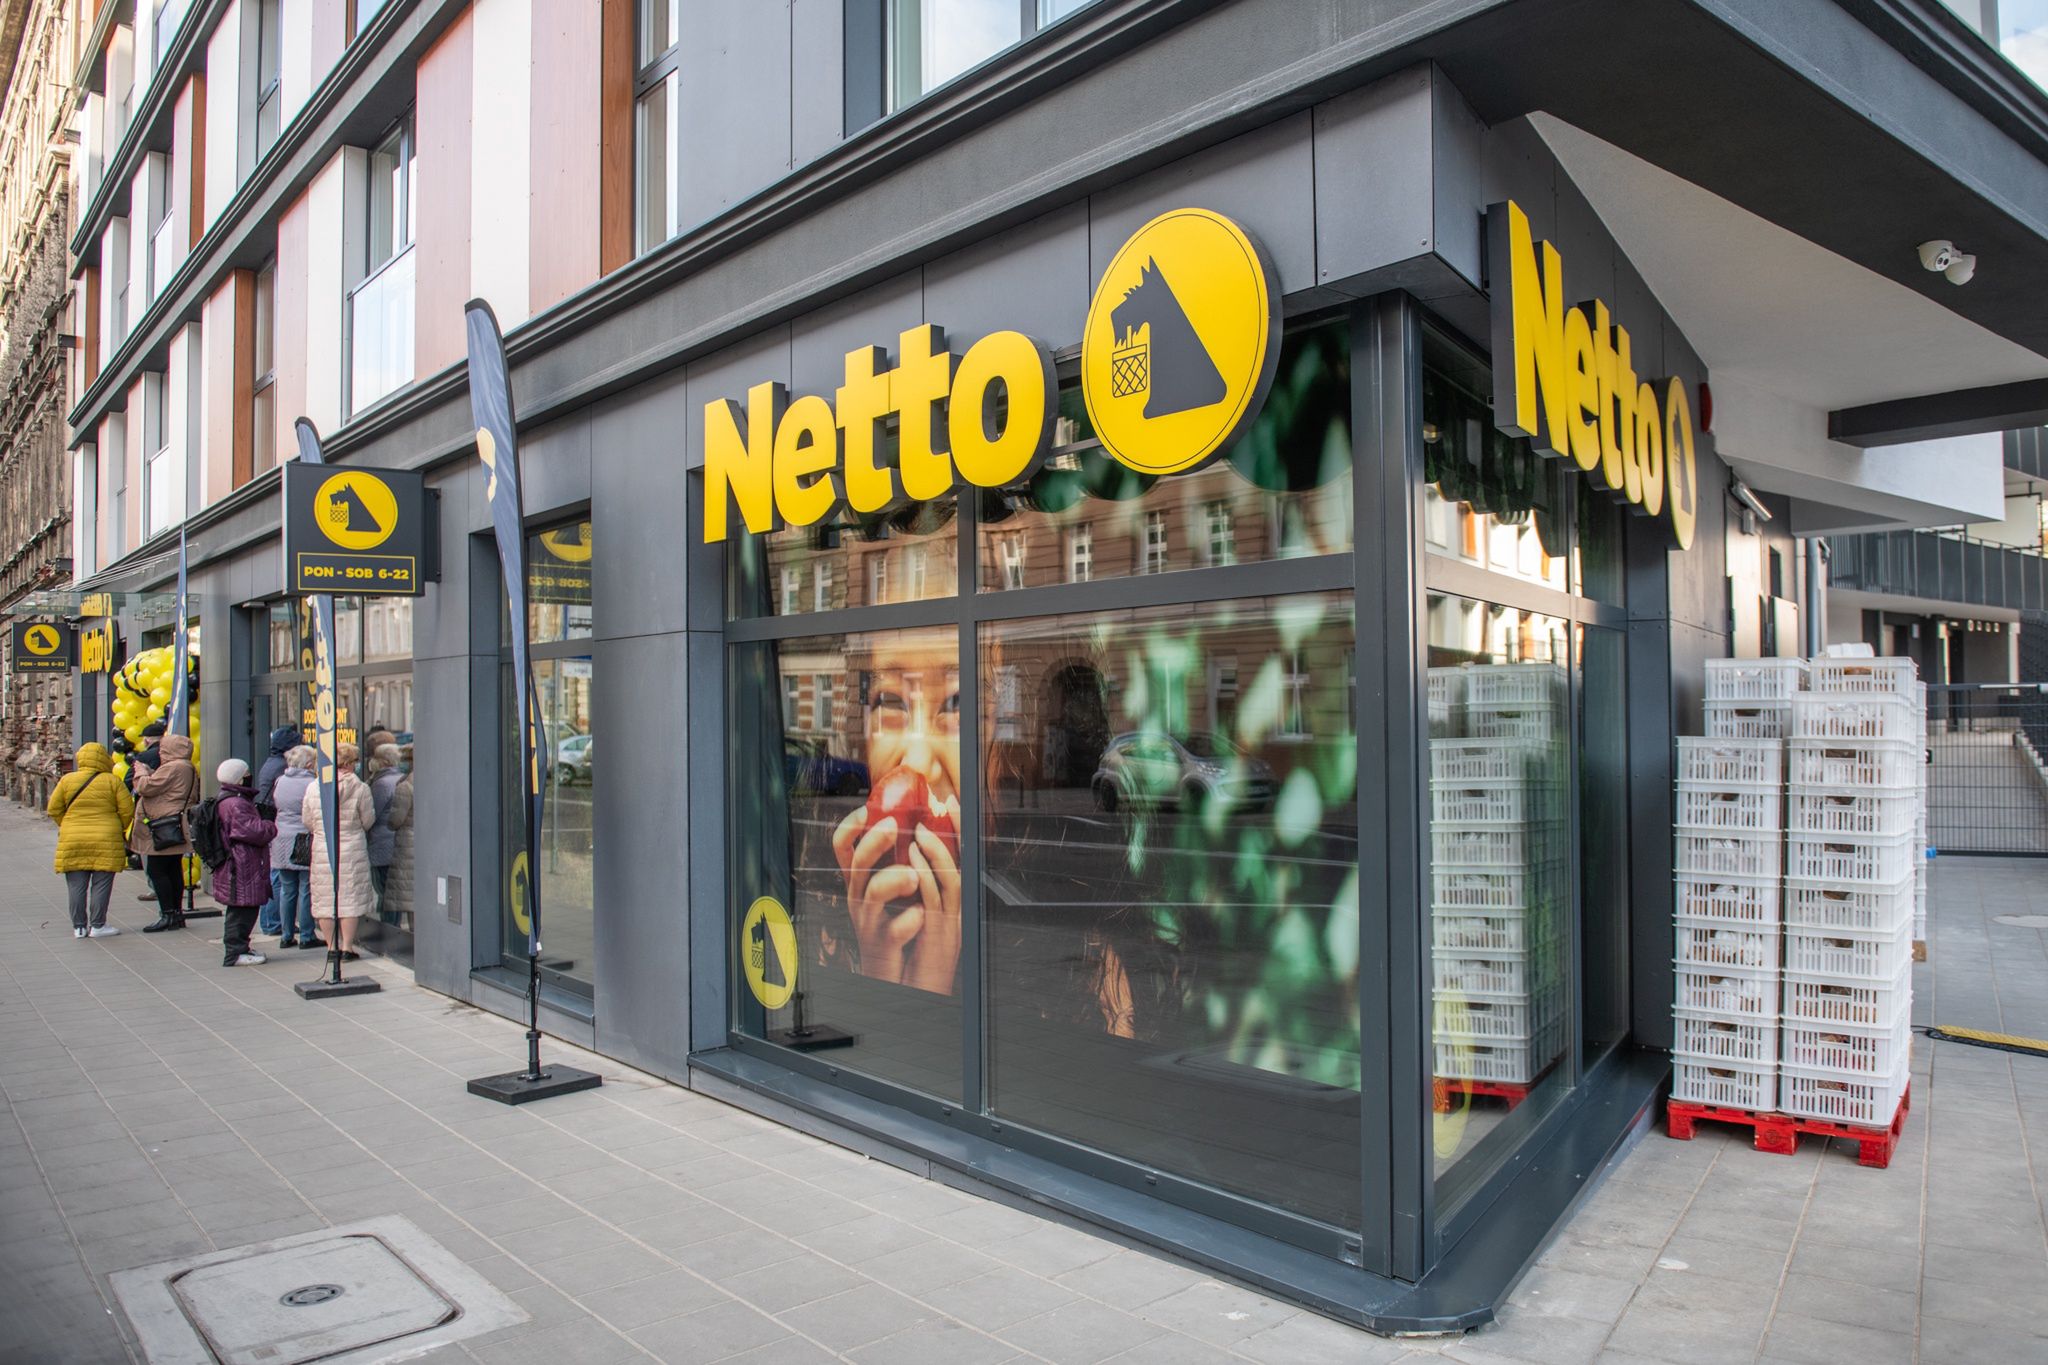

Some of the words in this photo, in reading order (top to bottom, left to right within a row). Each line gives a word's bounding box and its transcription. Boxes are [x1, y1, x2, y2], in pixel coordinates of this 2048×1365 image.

[1509, 199, 1664, 517] Netto
[704, 323, 1047, 543] Netto
[304, 566, 334, 578] PON
[346, 567, 374, 579] SOB
[378, 568, 409, 580] 6-22
[81, 628, 103, 673] Netto
